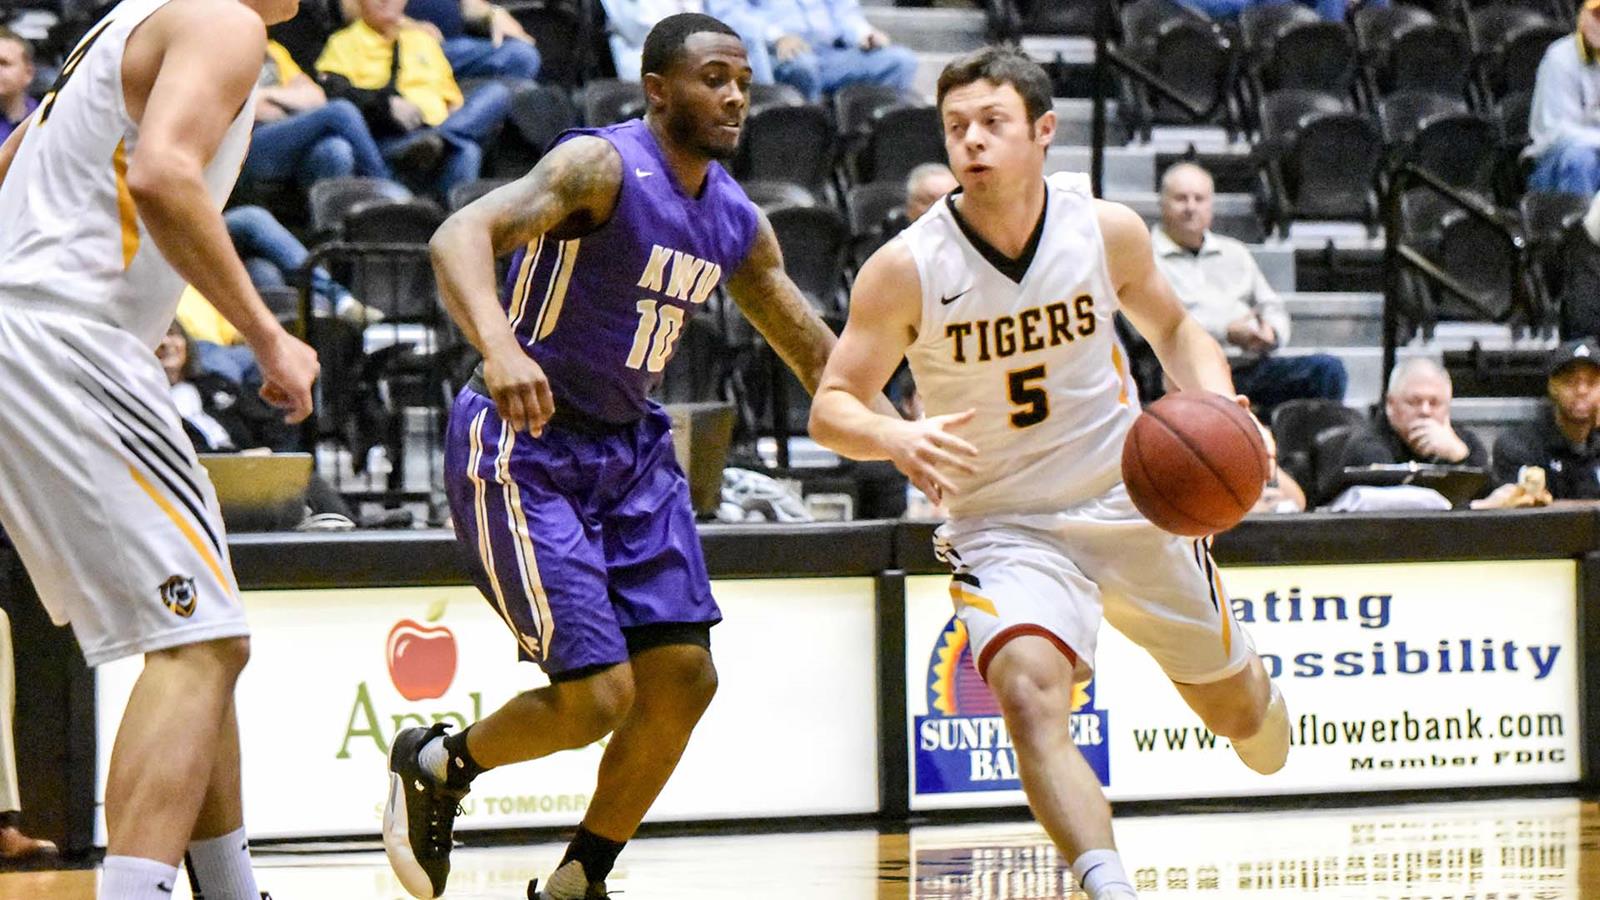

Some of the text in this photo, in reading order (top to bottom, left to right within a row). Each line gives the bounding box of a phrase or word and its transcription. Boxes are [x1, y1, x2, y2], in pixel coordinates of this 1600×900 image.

[637, 244, 721, 303] KWU
[625, 299, 685, 372] 10
[944, 294, 1096, 363] TIGERS
[1007, 363, 1050, 429] 5
[1230, 587, 1392, 629] ating
[1258, 639, 1561, 680] ossibility
[920, 713, 1103, 751] SUNFLER
[1134, 708, 1563, 752] www.flowerbank.com
[969, 748, 1020, 781] BA
[1350, 748, 1566, 770] Member FDIC
[484, 794, 586, 816] TOMORR
